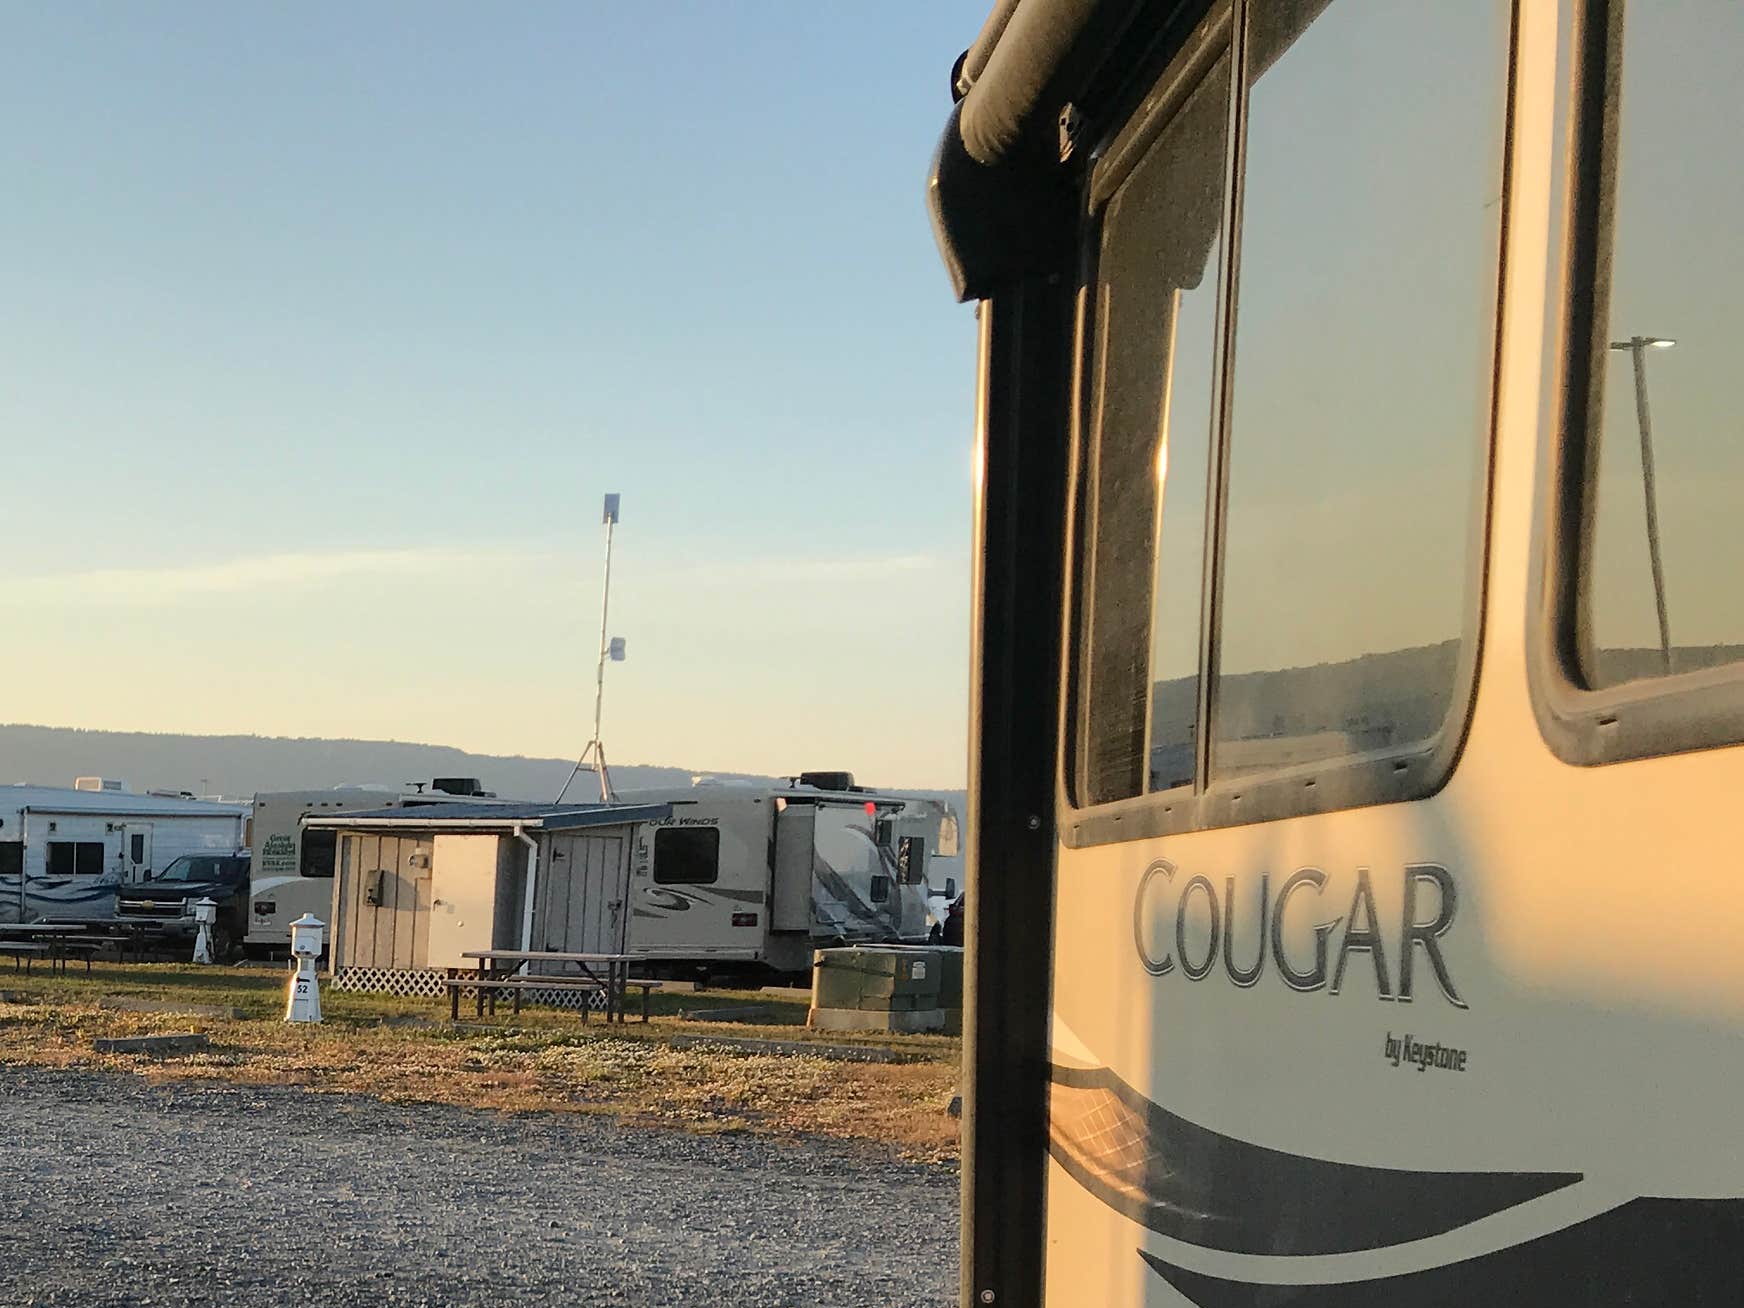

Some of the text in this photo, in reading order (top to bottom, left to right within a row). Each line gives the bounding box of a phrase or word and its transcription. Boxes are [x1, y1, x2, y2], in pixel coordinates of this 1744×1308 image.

[1132, 856, 1470, 1010] COUGAR
[297, 984, 308, 994] 52
[1384, 1031, 1467, 1073] by Keystone
